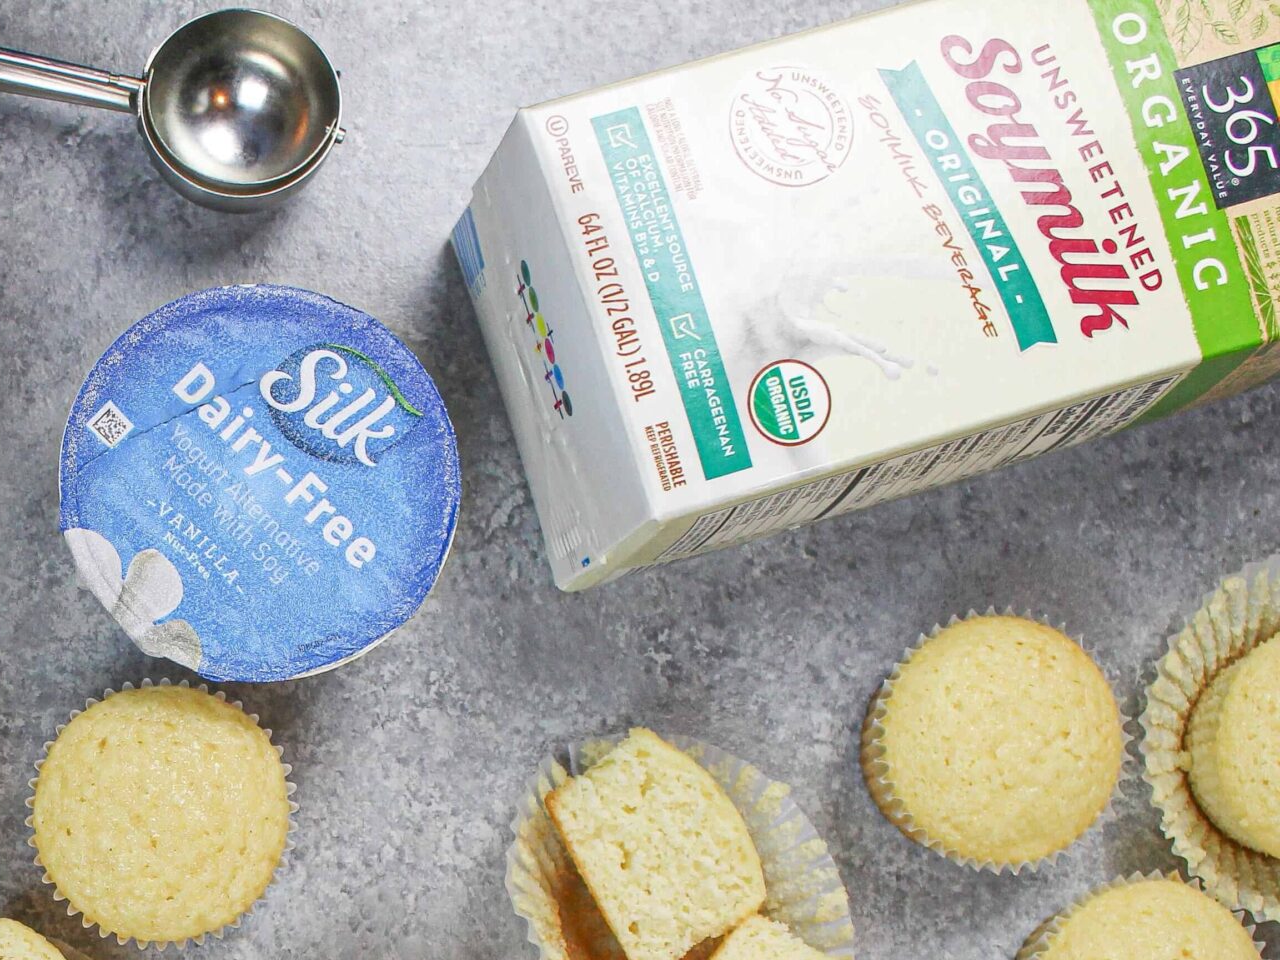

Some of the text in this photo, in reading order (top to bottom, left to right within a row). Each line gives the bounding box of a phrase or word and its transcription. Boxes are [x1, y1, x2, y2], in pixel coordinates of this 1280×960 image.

[555, 138, 585, 195] PAREVE
[625, 158, 641, 179] OF
[735, 109, 804, 180] UNSWEETENED
[791, 71, 849, 152] UNSWEETENED
[1030, 43, 1163, 293] UNSWEETENED
[1112, 12, 1229, 293] ORGANIC
[1180, 77, 1229, 200] EVERYDAY VALUE
[1201, 76, 1280, 178] 365
[612, 161, 660, 283] VITAMINS B12 & D
[638, 153, 675, 232] EXCELLENT
[665, 234, 694, 293] SOURCE
[858, 93, 999, 340] SOYMILK BEVERAGE
[939, 33, 1140, 339] Soymilk
[577, 212, 657, 403] 64 FL OZ (1/2 GAL) 1.89L
[259, 349, 397, 467] Silk
[678, 351, 701, 390] FREE
[693, 347, 736, 459] CARRAGEENAN
[765, 376, 795, 436] ORGANIC
[788, 375, 816, 424] USDA
[172, 361, 377, 569] Dairy-Free
[172, 423, 231, 485] Yogurt
[224, 480, 320, 578] Alternative
[644, 425, 672, 493] KEEP REFRIGERATED
[654, 420, 688, 489] PERISHABLE
[161, 455, 290, 586] Made with Soy
[163, 530, 211, 580] Nut-Free
